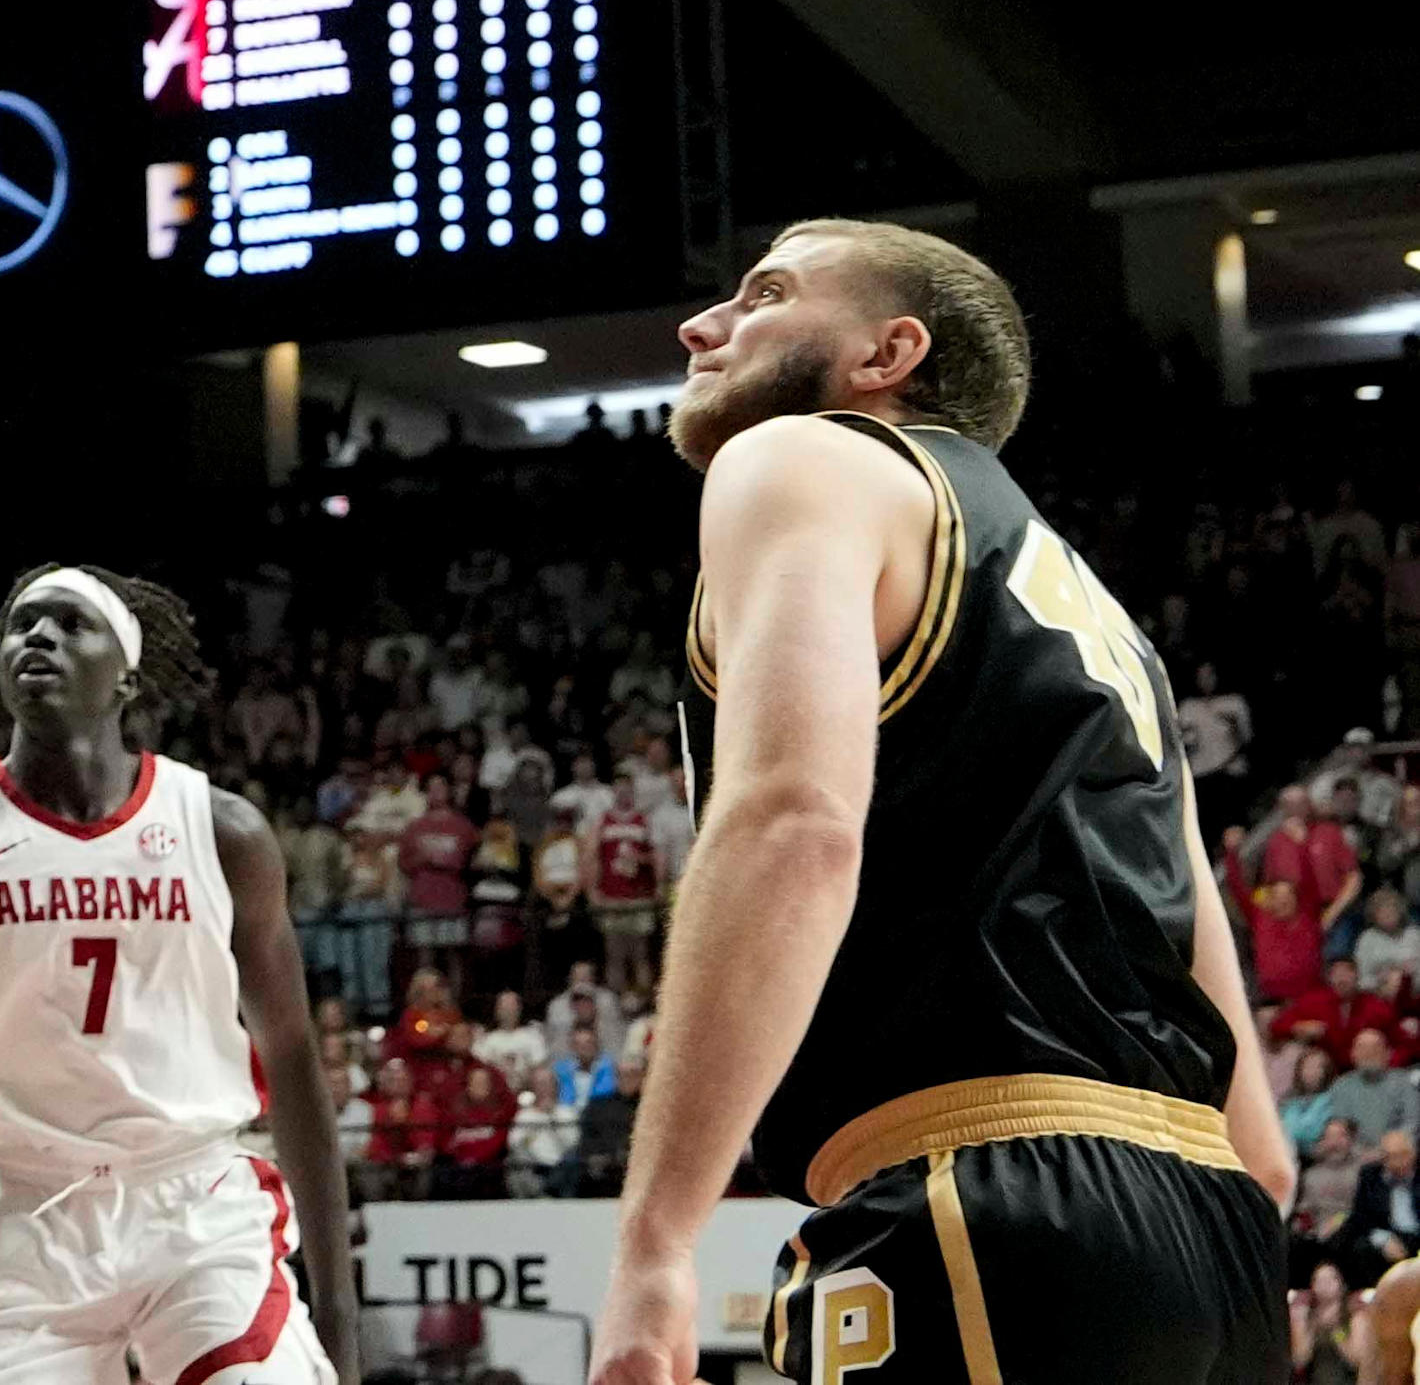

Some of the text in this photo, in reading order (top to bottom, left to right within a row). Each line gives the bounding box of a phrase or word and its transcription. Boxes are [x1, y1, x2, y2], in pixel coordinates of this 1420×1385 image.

[72, 937, 118, 1035] 7
[403, 1253, 549, 1307] TIDE
[811, 1266, 896, 1385] P
